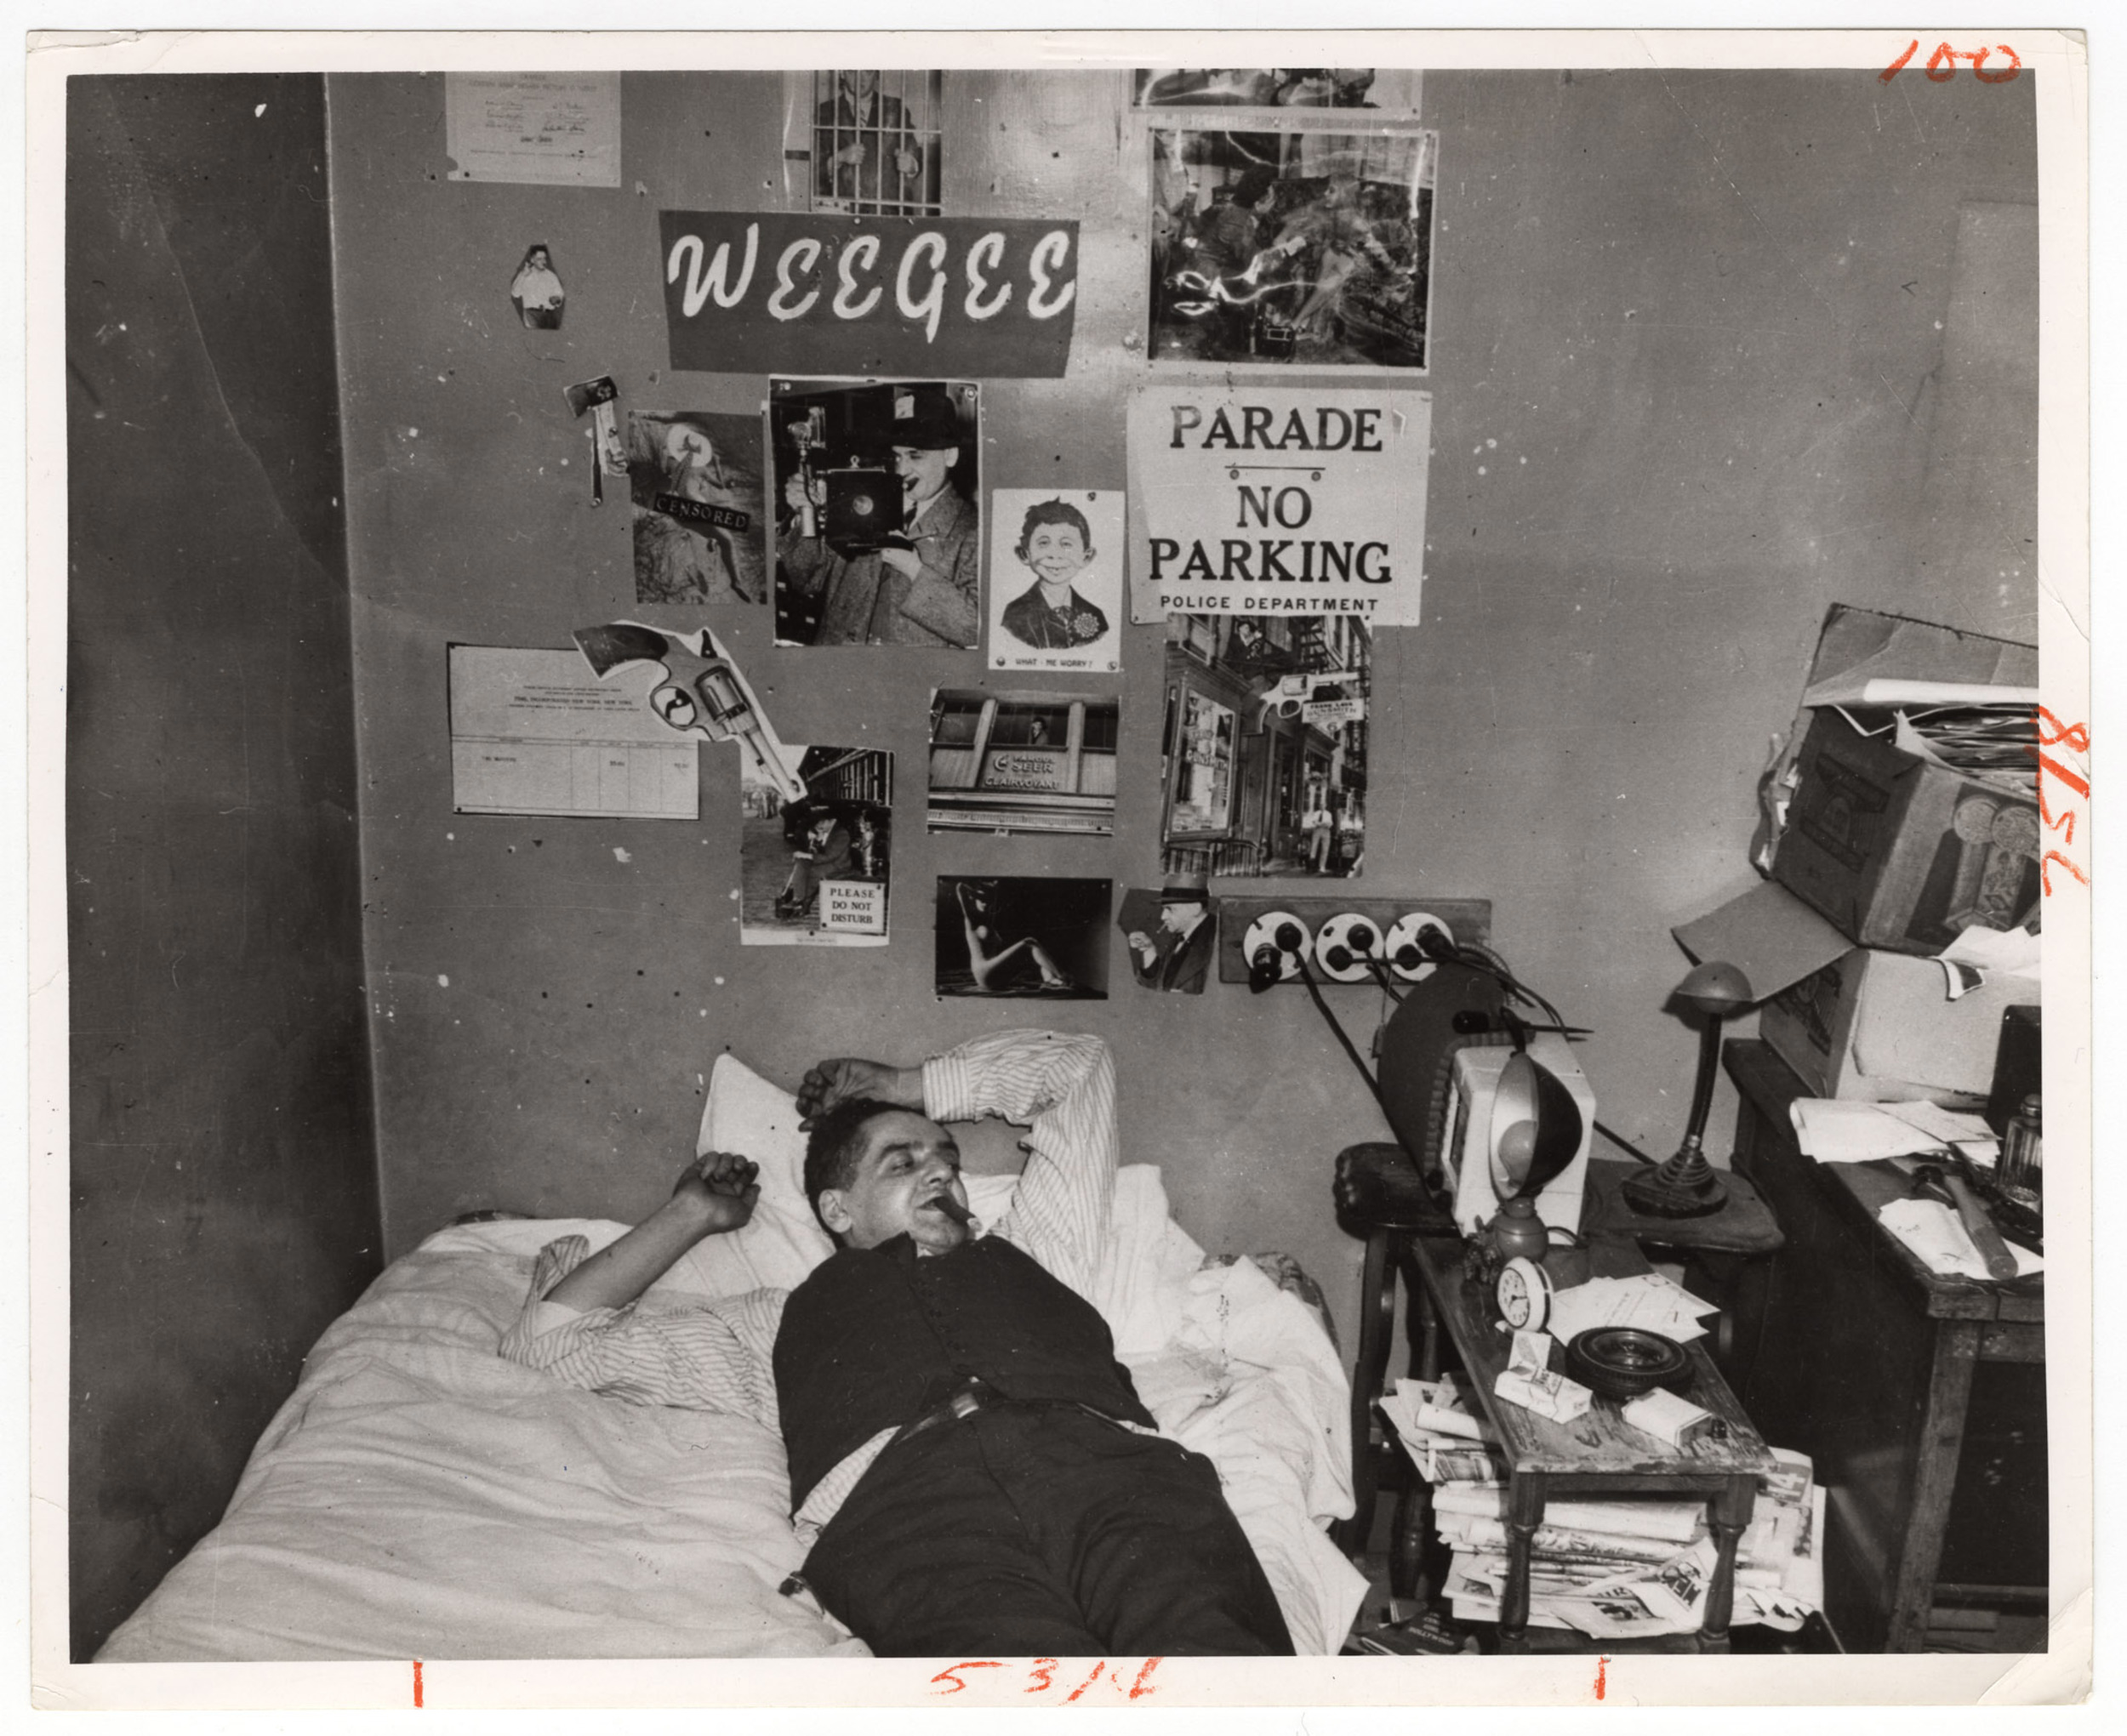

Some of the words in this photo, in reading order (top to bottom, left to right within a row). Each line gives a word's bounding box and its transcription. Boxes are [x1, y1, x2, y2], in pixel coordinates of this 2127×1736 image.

[1878, 39, 2022, 86] 100
[668, 222, 1075, 344] WEEGEE
[1170, 405, 1383, 452] PARADE
[656, 497, 747, 528] CENSORED
[1236, 486, 1312, 529] NO
[1149, 538, 1393, 583] PARKING
[1160, 595, 1231, 609] POLICE
[1244, 597, 1379, 612] DEPARTMENT
[1046, 658, 1057, 667] ME
[1011, 762, 1053, 774] SEER
[984, 777, 1060, 790] CLAIRVOYANT
[830, 887, 875, 899] PLEASE
[831, 901, 847, 910] DO
[851, 902, 873, 912] NOT
[830, 914, 874, 925] DISTURB
